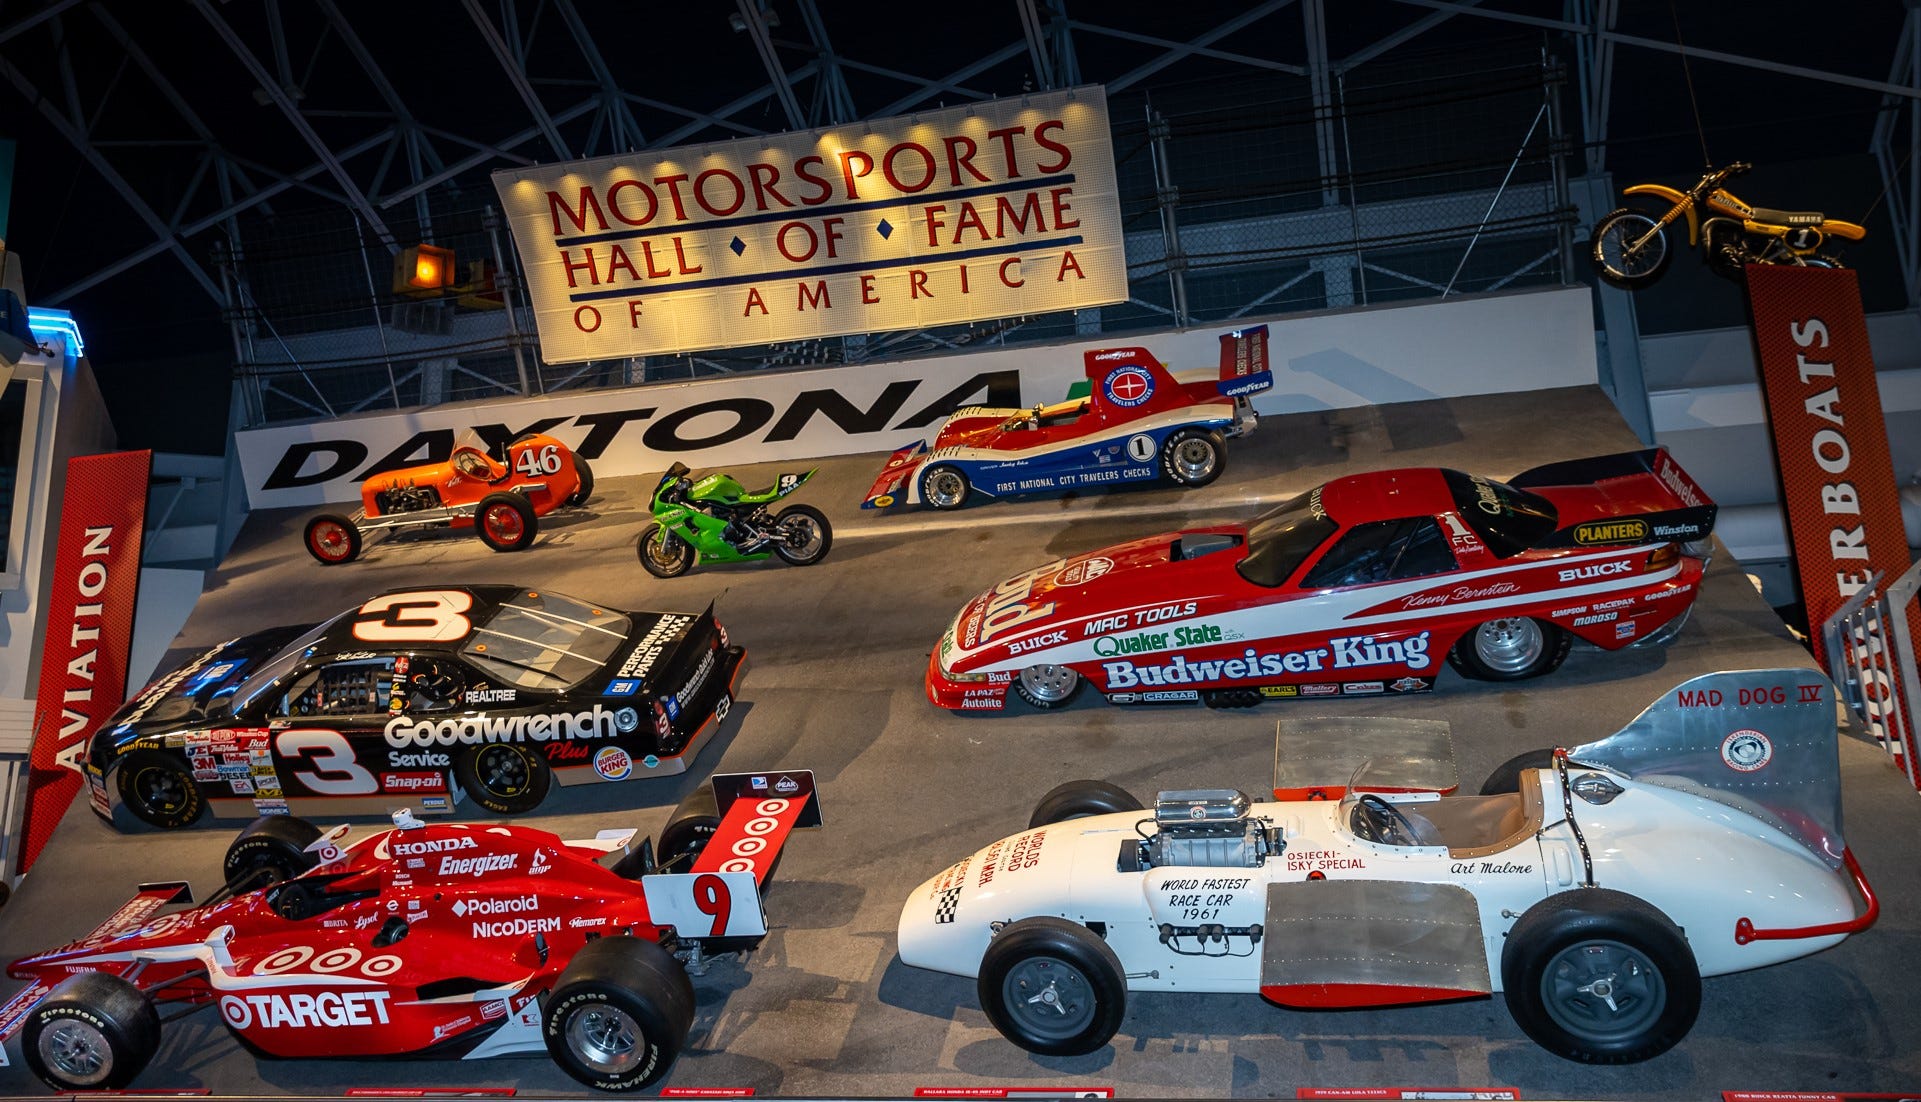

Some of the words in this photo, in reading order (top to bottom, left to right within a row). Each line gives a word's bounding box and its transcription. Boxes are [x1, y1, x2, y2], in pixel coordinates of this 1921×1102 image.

[547, 120, 1072, 235] MOTORSPORTS
[562, 236, 703, 288] HALL
[776, 217, 845, 262] OF
[925, 187, 1081, 247] FAME
[1793, 229, 1810, 248] 1
[574, 300, 643, 333] OF
[744, 250, 1085, 317] AMERICA
[1226, 381, 1270, 396] GOODYEAR
[262, 370, 1021, 490] DAYTONA
[1134, 437, 1144, 456] 1
[516, 445, 561, 477] 46
[781, 474, 798, 487] 9
[996, 483, 1016, 492] FIRST
[1020, 479, 1055, 490] NATIONAL
[1059, 475, 1076, 485] CITY
[1079, 471, 1119, 482] TRAVELERS
[1123, 467, 1151, 479] CHECKS
[1445, 514, 1471, 536] 1
[1579, 523, 1643, 542] PLANTERS
[1653, 524, 1698, 536] Winston
[1452, 535, 1478, 546] FC
[1558, 560, 1633, 582] BUICK
[1402, 591, 1449, 608] Kenny
[1451, 582, 1521, 600] Bernstein
[1644, 584, 1692, 601] GOODYEAR
[353, 590, 472, 642] 3
[1551, 606, 1587, 618] SIMPSON
[1592, 597, 1635, 611] RACEPAK
[1083, 615, 1128, 636] MAC
[1135, 602, 1197, 623] TOOLS
[1573, 612, 1618, 627] MOROSO
[617, 614, 676, 677] PERFORMANCE
[1008, 630, 1069, 655] BUICK
[1093, 631, 1169, 657] Quaker
[1174, 623, 1222, 646] State
[55, 527, 113, 774] AVIATION
[1102, 648, 1328, 689] Budweiser
[1329, 631, 1431, 669] King
[632, 646, 663, 677] PARTS
[988, 671, 1012, 682] Bud
[465, 689, 516, 703] REALTREE
[611, 682, 634, 693] GM
[1146, 692, 1196, 700] CRAGAR
[1678, 689, 1723, 707] MAD
[1739, 686, 1786, 705] DOG
[1797, 684, 1823, 702] IV
[961, 698, 1002, 708] Autolite
[384, 704, 617, 749] Goodwrench
[116, 738, 160, 756] GOODYEAR
[248, 739, 269, 748] Bud
[544, 741, 589, 760] Plus
[193, 756, 216, 770] 3M
[225, 754, 250, 763] Holley
[275, 729, 379, 796] 3
[388, 750, 451, 767] Service
[598, 751, 625, 767] BURGER
[601, 759, 628, 775] KING
[385, 774, 443, 789] Snap-on
[228, 841, 268, 868] Firestone
[393, 836, 479, 855] HONDA
[1008, 835, 1030, 871] RECORD
[438, 852, 518, 877] Energizer
[1287, 851, 1341, 861] OSIECKI-
[1287, 861, 1316, 871] ISKY
[1319, 858, 1366, 870] SPECIAL
[1450, 861, 1475, 875] Art
[1479, 861, 1533, 874] Malone
[1160, 878, 1199, 891] WORLD
[1201, 877, 1251, 890] FASTEST
[467, 894, 538, 915] Polaroid
[693, 874, 731, 936] 9
[1169, 894, 1201, 907] RACE
[1205, 894, 1234, 906] CAR
[329, 919, 348, 927] BRITA
[355, 912, 378, 930] Lysol
[569, 917, 606, 928] Memorex
[1182, 908, 1219, 920] 1961
[65, 966, 96, 974] FUJIFILM
[40, 1008, 104, 1028] Firestone
[246, 991, 390, 1028] TARGET
[549, 993, 607, 1036] Firestone
[595, 1043, 657, 1090] FIREHAWK
